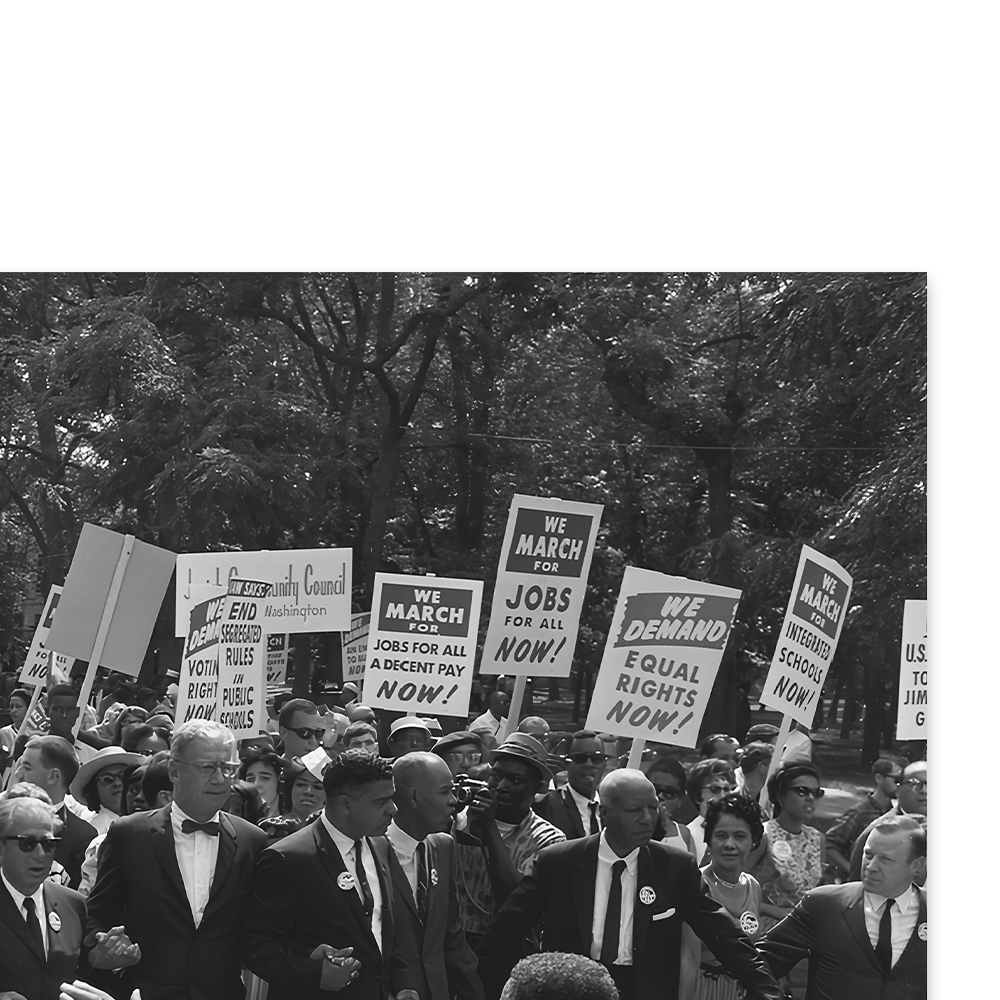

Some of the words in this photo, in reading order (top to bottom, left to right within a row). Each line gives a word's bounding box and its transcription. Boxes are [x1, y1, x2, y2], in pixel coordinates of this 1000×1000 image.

[543, 515, 568, 535] WE
[514, 533, 584, 561] MARCH
[533, 560, 559, 573] FOR
[304, 562, 346, 596] Council
[822, 572, 839, 595] WE
[413, 589, 441, 604] WE
[505, 584, 573, 613] JOBS
[659, 595, 706, 619] WE
[799, 583, 842, 624] MARCH
[228, 601, 257, 621] END
[263, 603, 327, 622] Washington
[385, 602, 465, 624] MARCH
[809, 612, 826, 629] FOR
[408, 622, 439, 633] FOR
[504, 615, 533, 628] FOR
[539, 618, 564, 630] ALL
[623, 619, 727, 643] DEMAND
[220, 623, 262, 644] SEGREGATED
[785, 620, 831, 661] INTEGRATED
[226, 646, 255, 667] RULES
[373, 639, 409, 653] JOBS
[412, 642, 440, 655] FOR
[442, 644, 467, 658] ALL
[494, 636, 567, 664] NOW!
[370, 657, 382, 670] A
[383, 658, 435, 675] DECENT
[437, 663, 466, 678] PAY
[624, 650, 700, 685] EQUAL
[778, 646, 824, 686] SCHOOLS
[187, 681, 218, 699] RIGHT
[222, 686, 255, 707] PUBLIC
[376, 680, 459, 705] NOW!
[615, 673, 698, 708] RIGHTS
[772, 675, 816, 713] NOW!
[903, 690, 928, 705] JIM
[220, 709, 255, 730] SCHOOLS
[606, 700, 695, 736] NOW!
